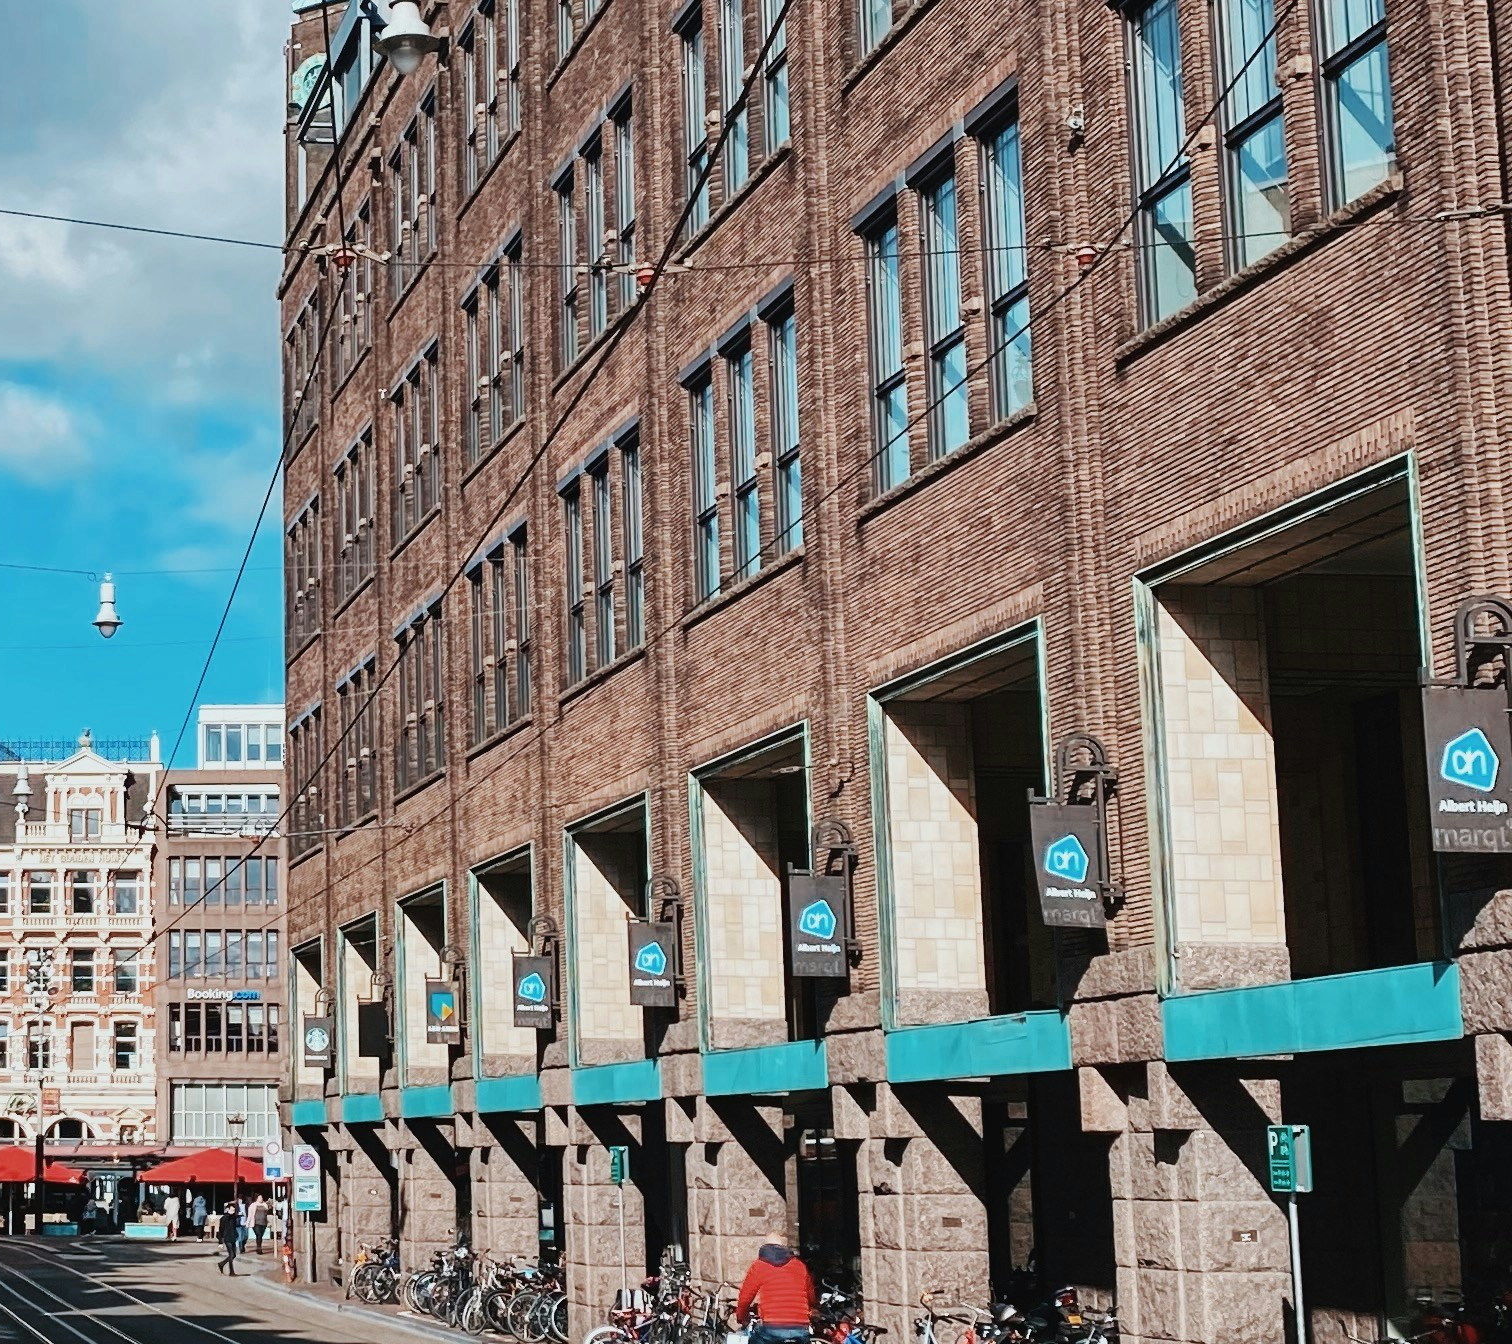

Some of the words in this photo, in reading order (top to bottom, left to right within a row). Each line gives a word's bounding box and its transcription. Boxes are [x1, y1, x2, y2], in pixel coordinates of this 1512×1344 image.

[1439, 799, 1476, 813] Albert
[1477, 800, 1508, 815] Heijn
[187, 987, 261, 1002] Booking.com
[1268, 1131, 1279, 1156] P
